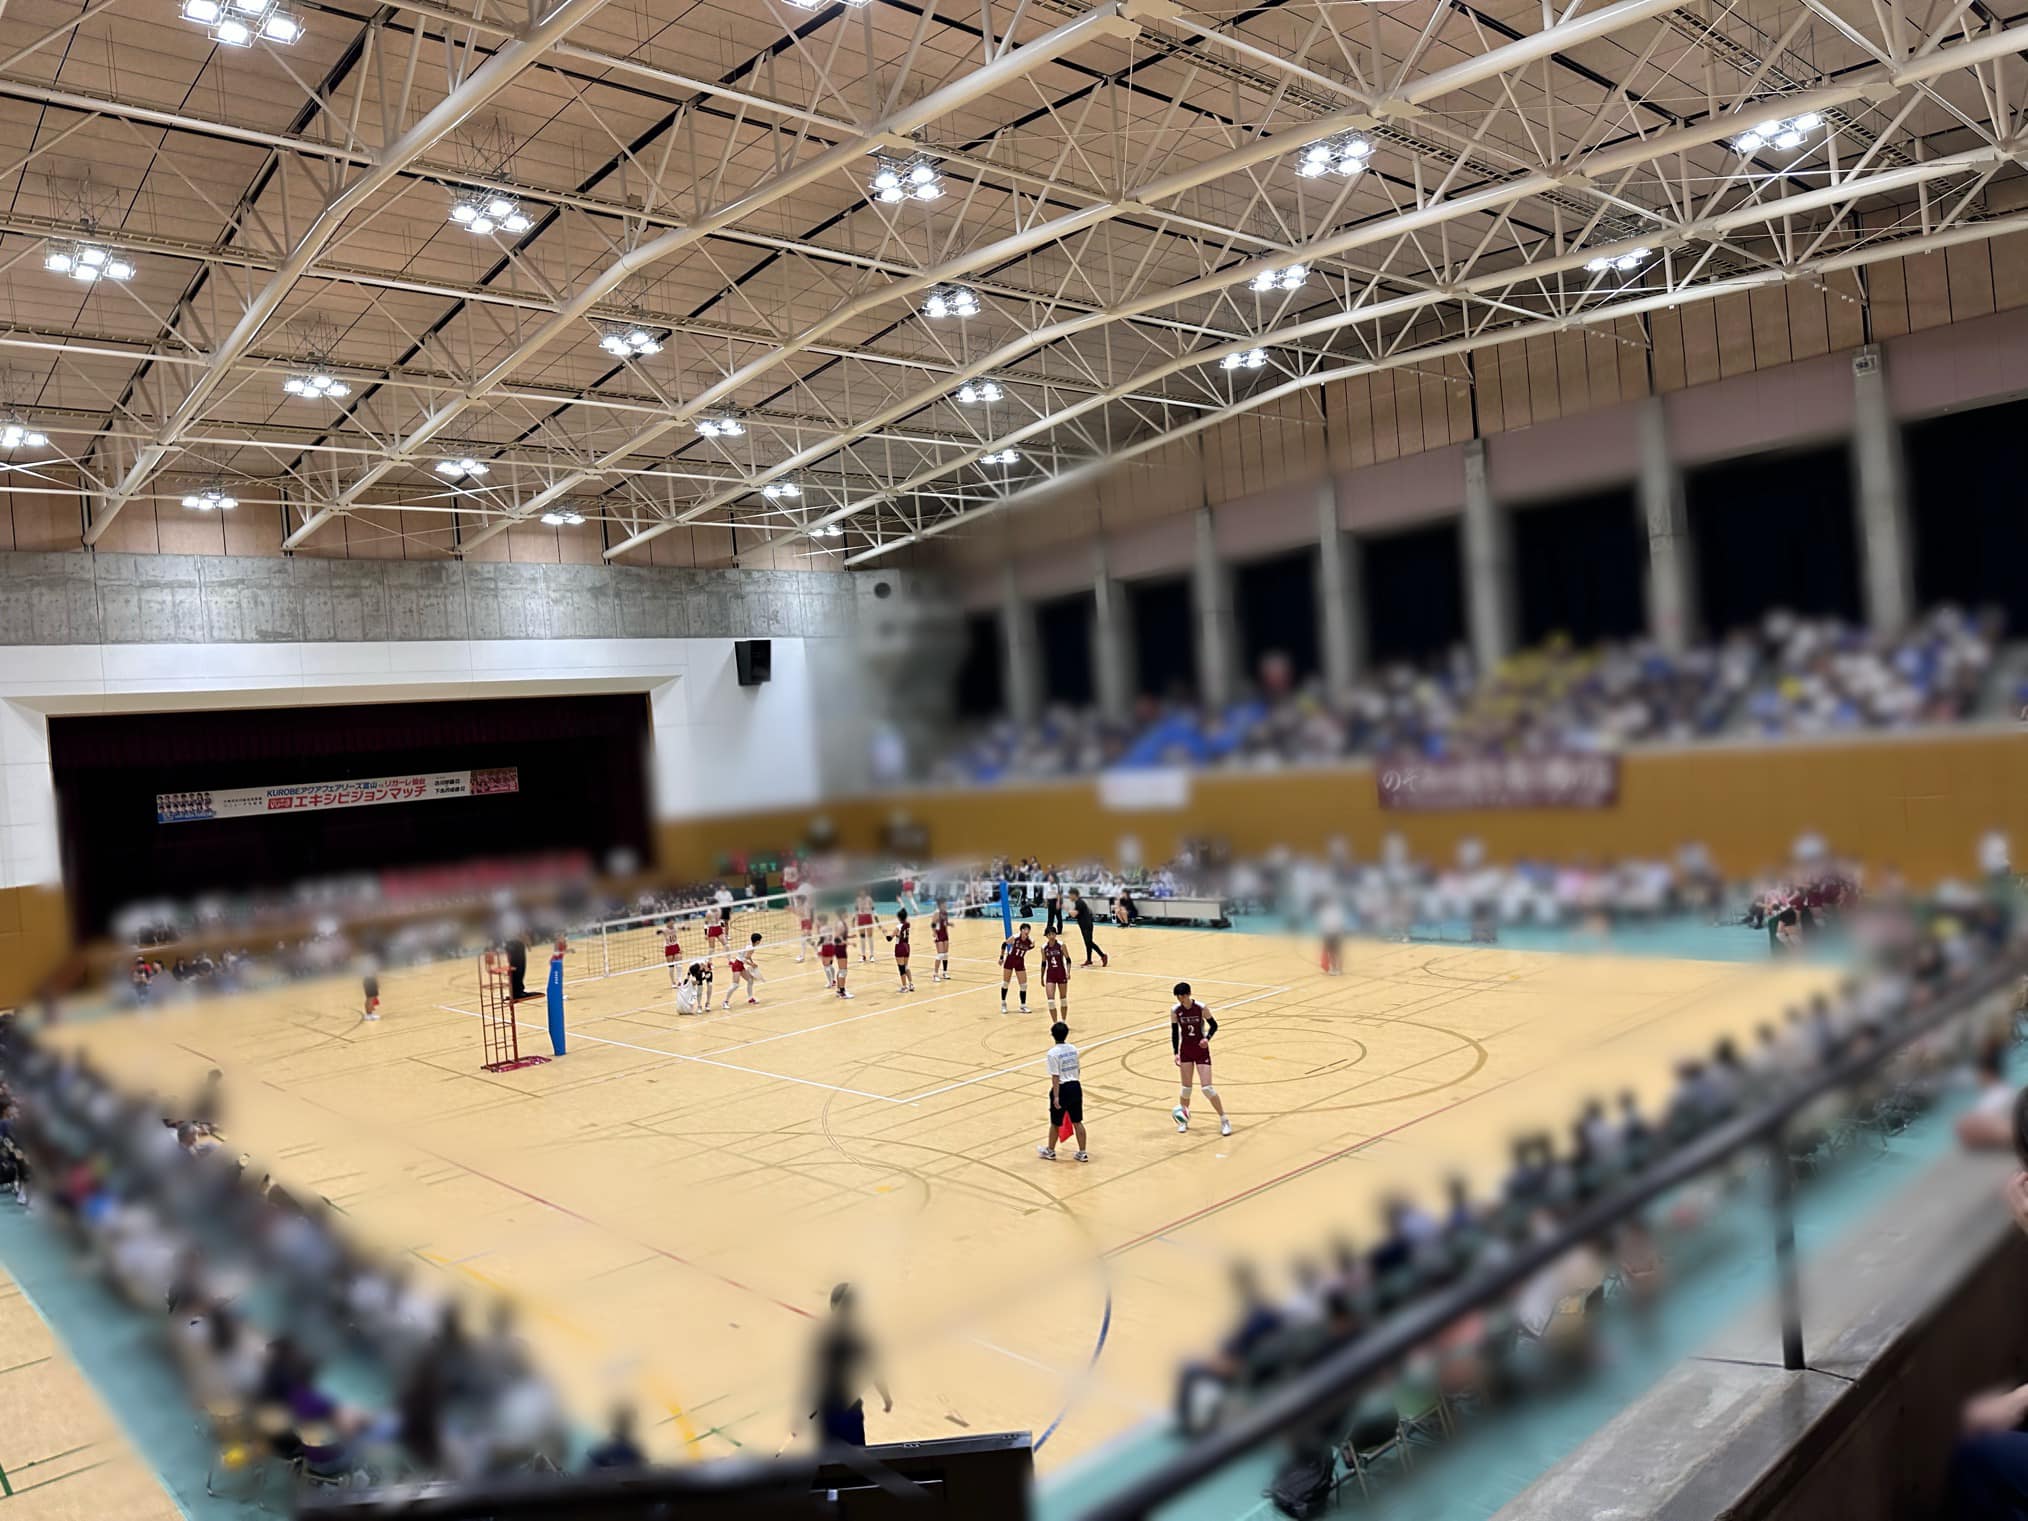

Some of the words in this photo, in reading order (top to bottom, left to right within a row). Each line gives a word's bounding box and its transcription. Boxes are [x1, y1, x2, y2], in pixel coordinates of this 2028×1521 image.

[294, 785, 427, 807] エキシビションマッチ
[1187, 1024, 1196, 1036] 2
